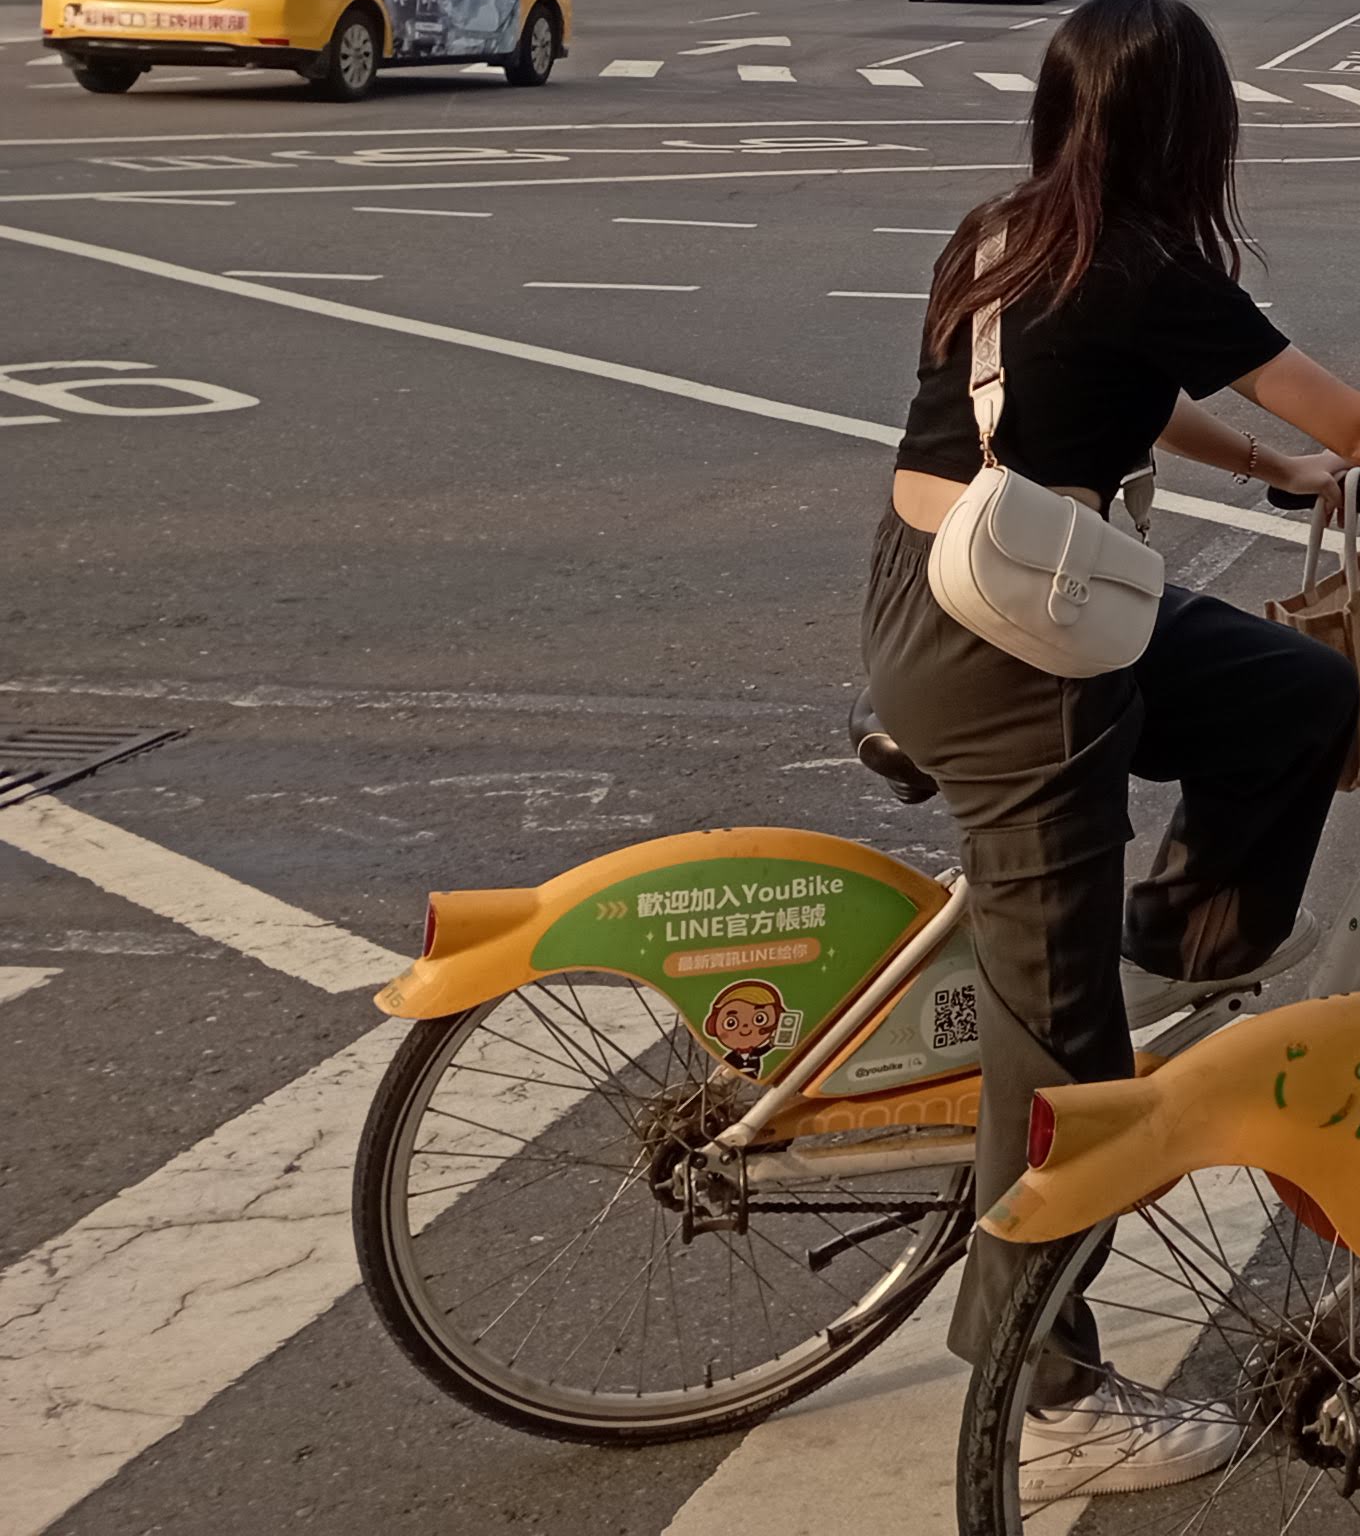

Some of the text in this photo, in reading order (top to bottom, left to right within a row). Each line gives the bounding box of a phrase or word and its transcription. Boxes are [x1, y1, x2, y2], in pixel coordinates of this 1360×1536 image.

[637, 875, 844, 918] 歡迎加入YouBike
[666, 903, 826, 942] LINE官方帳號
[678, 943, 809, 972] 最新資訊LINE給你
[855, 1062, 904, 1079] @youbike
